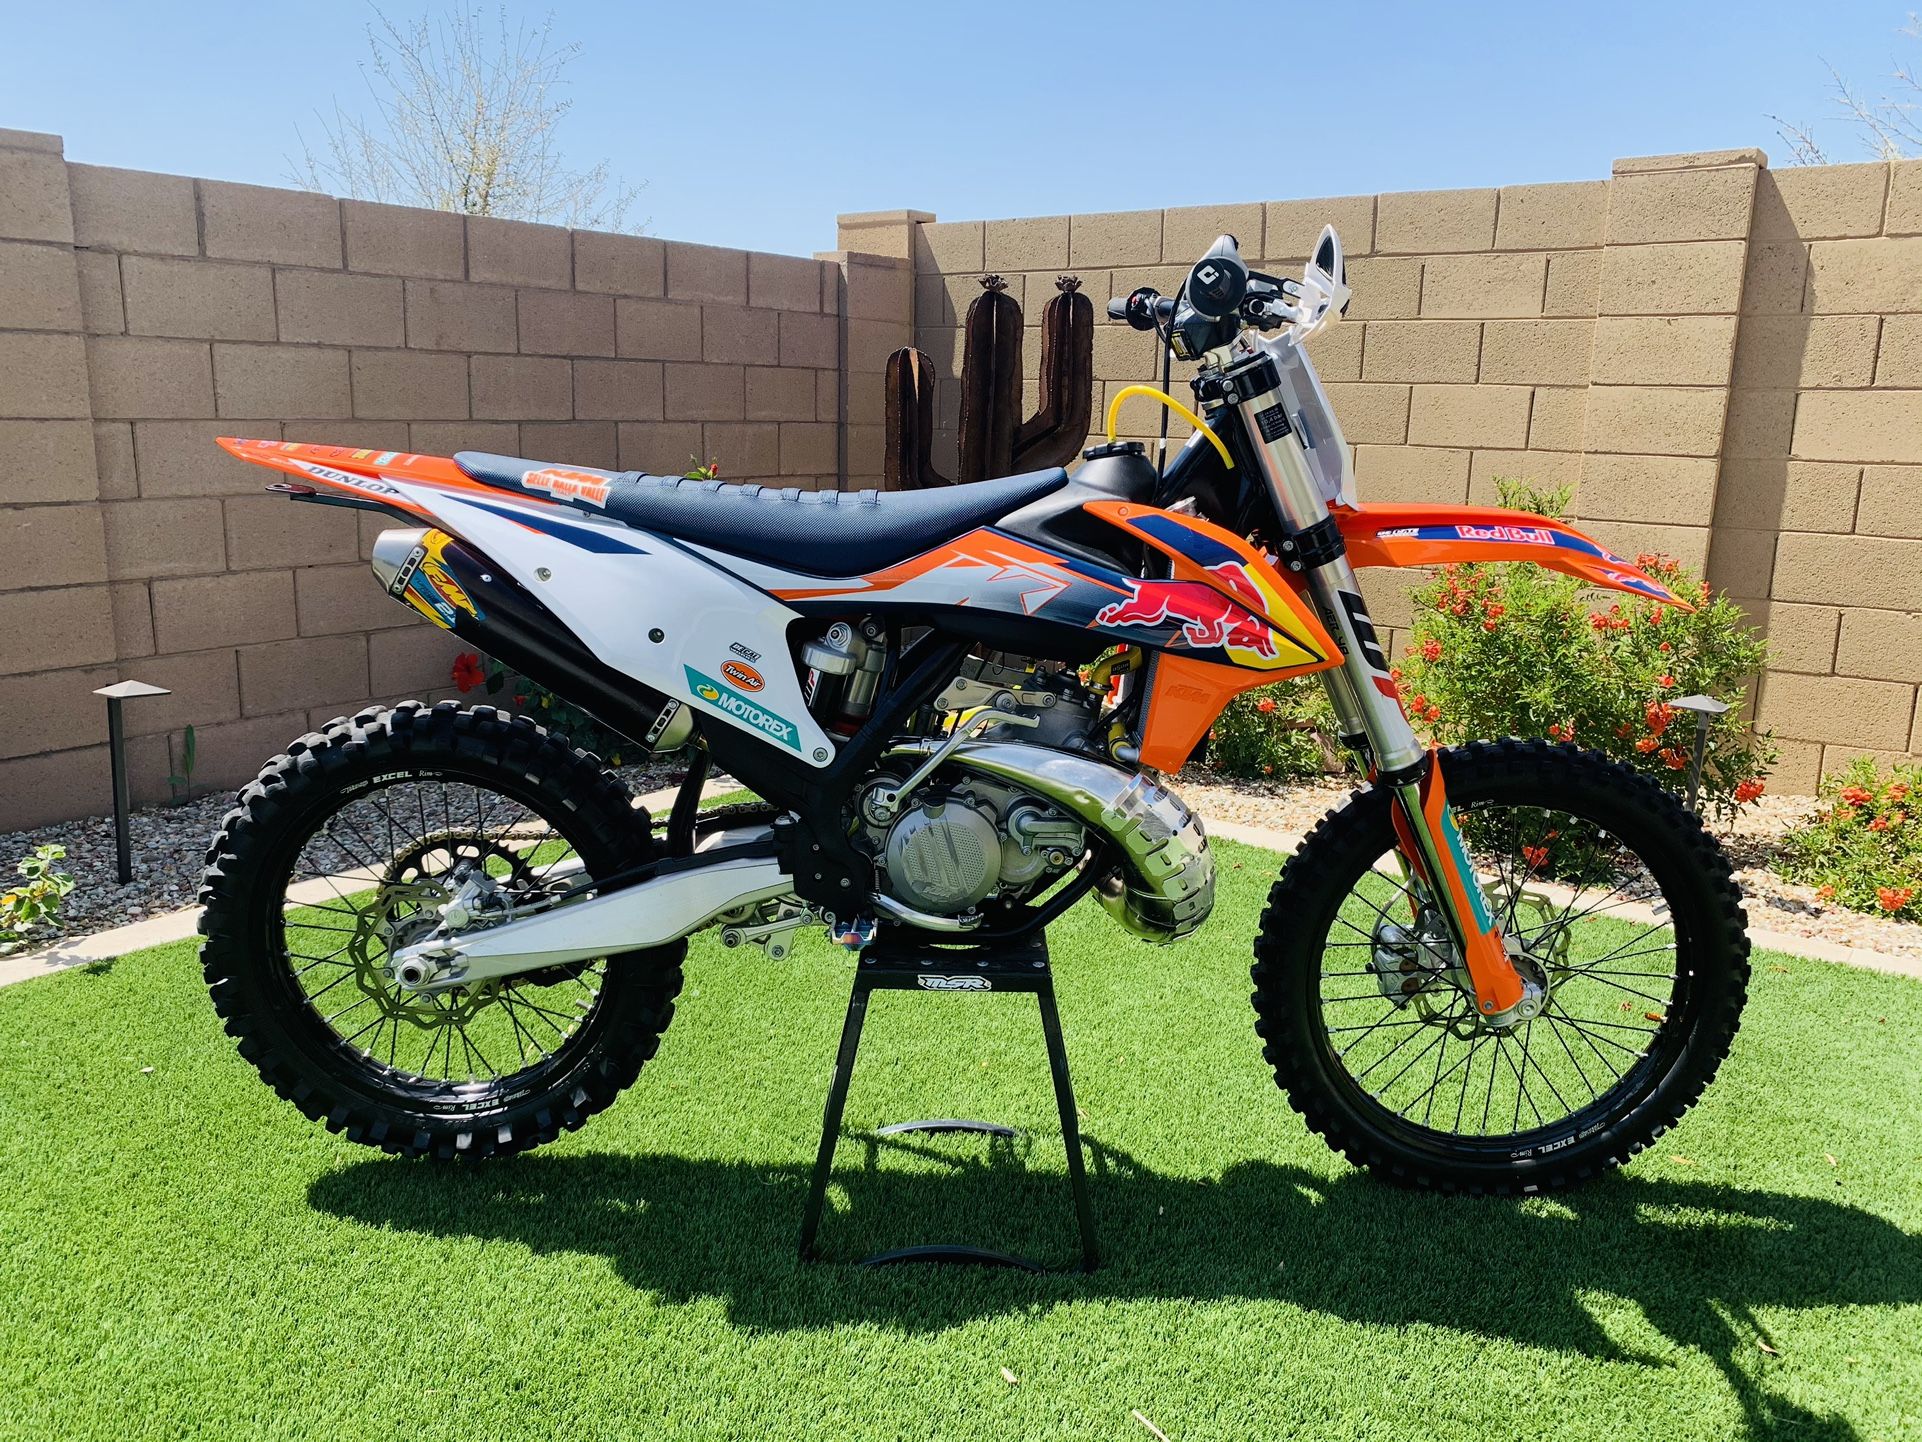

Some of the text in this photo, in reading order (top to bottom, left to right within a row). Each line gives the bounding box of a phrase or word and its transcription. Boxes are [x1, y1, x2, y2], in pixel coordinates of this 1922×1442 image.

[306, 465, 401, 496] DUNLOP
[1455, 525, 1556, 545] Red Bull
[422, 562, 479, 617] FMF
[723, 665, 760, 687] Twin Air
[718, 693, 793, 740] MOTOREX
[372, 770, 413, 784] EXCEL
[924, 975, 986, 990] MSR
[462, 1098, 500, 1111] EXCEL
[1538, 1136, 1576, 1154] EXCEL
